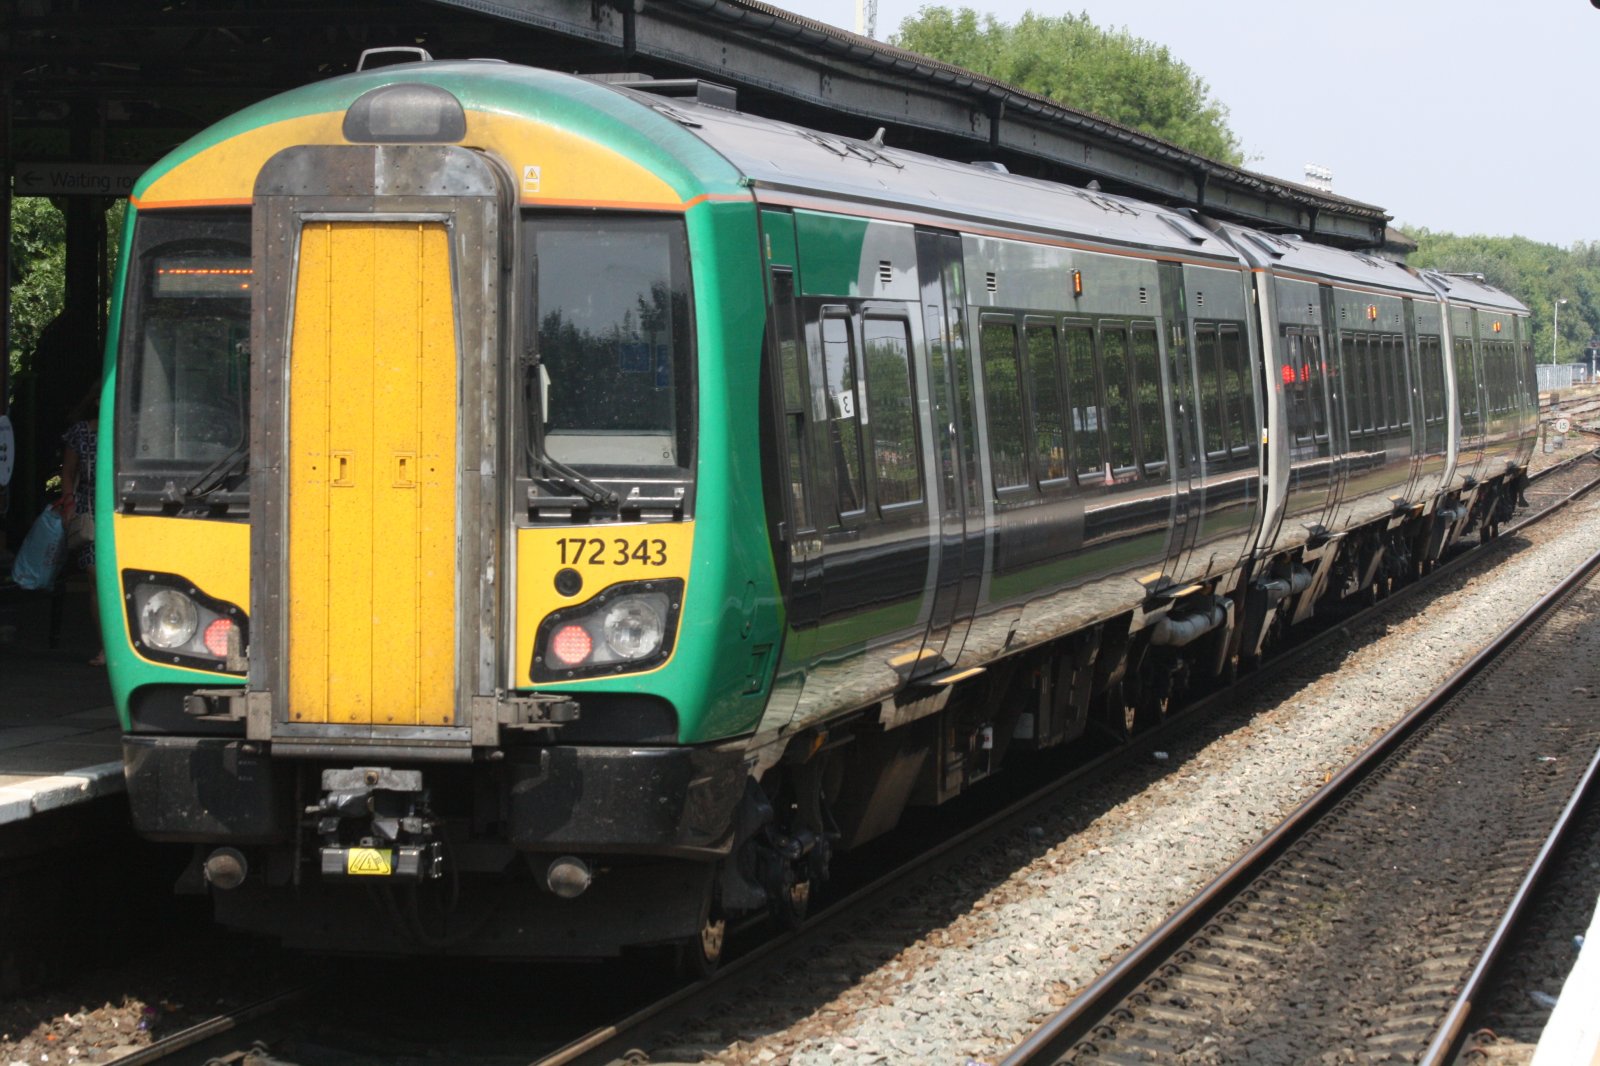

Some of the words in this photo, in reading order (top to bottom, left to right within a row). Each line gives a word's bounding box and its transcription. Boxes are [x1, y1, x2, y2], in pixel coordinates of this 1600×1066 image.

[50, 172, 111, 192] Waiting
[117, 176, 137, 188] ro
[556, 538, 606, 565] 172
[612, 538, 668, 566] 343
